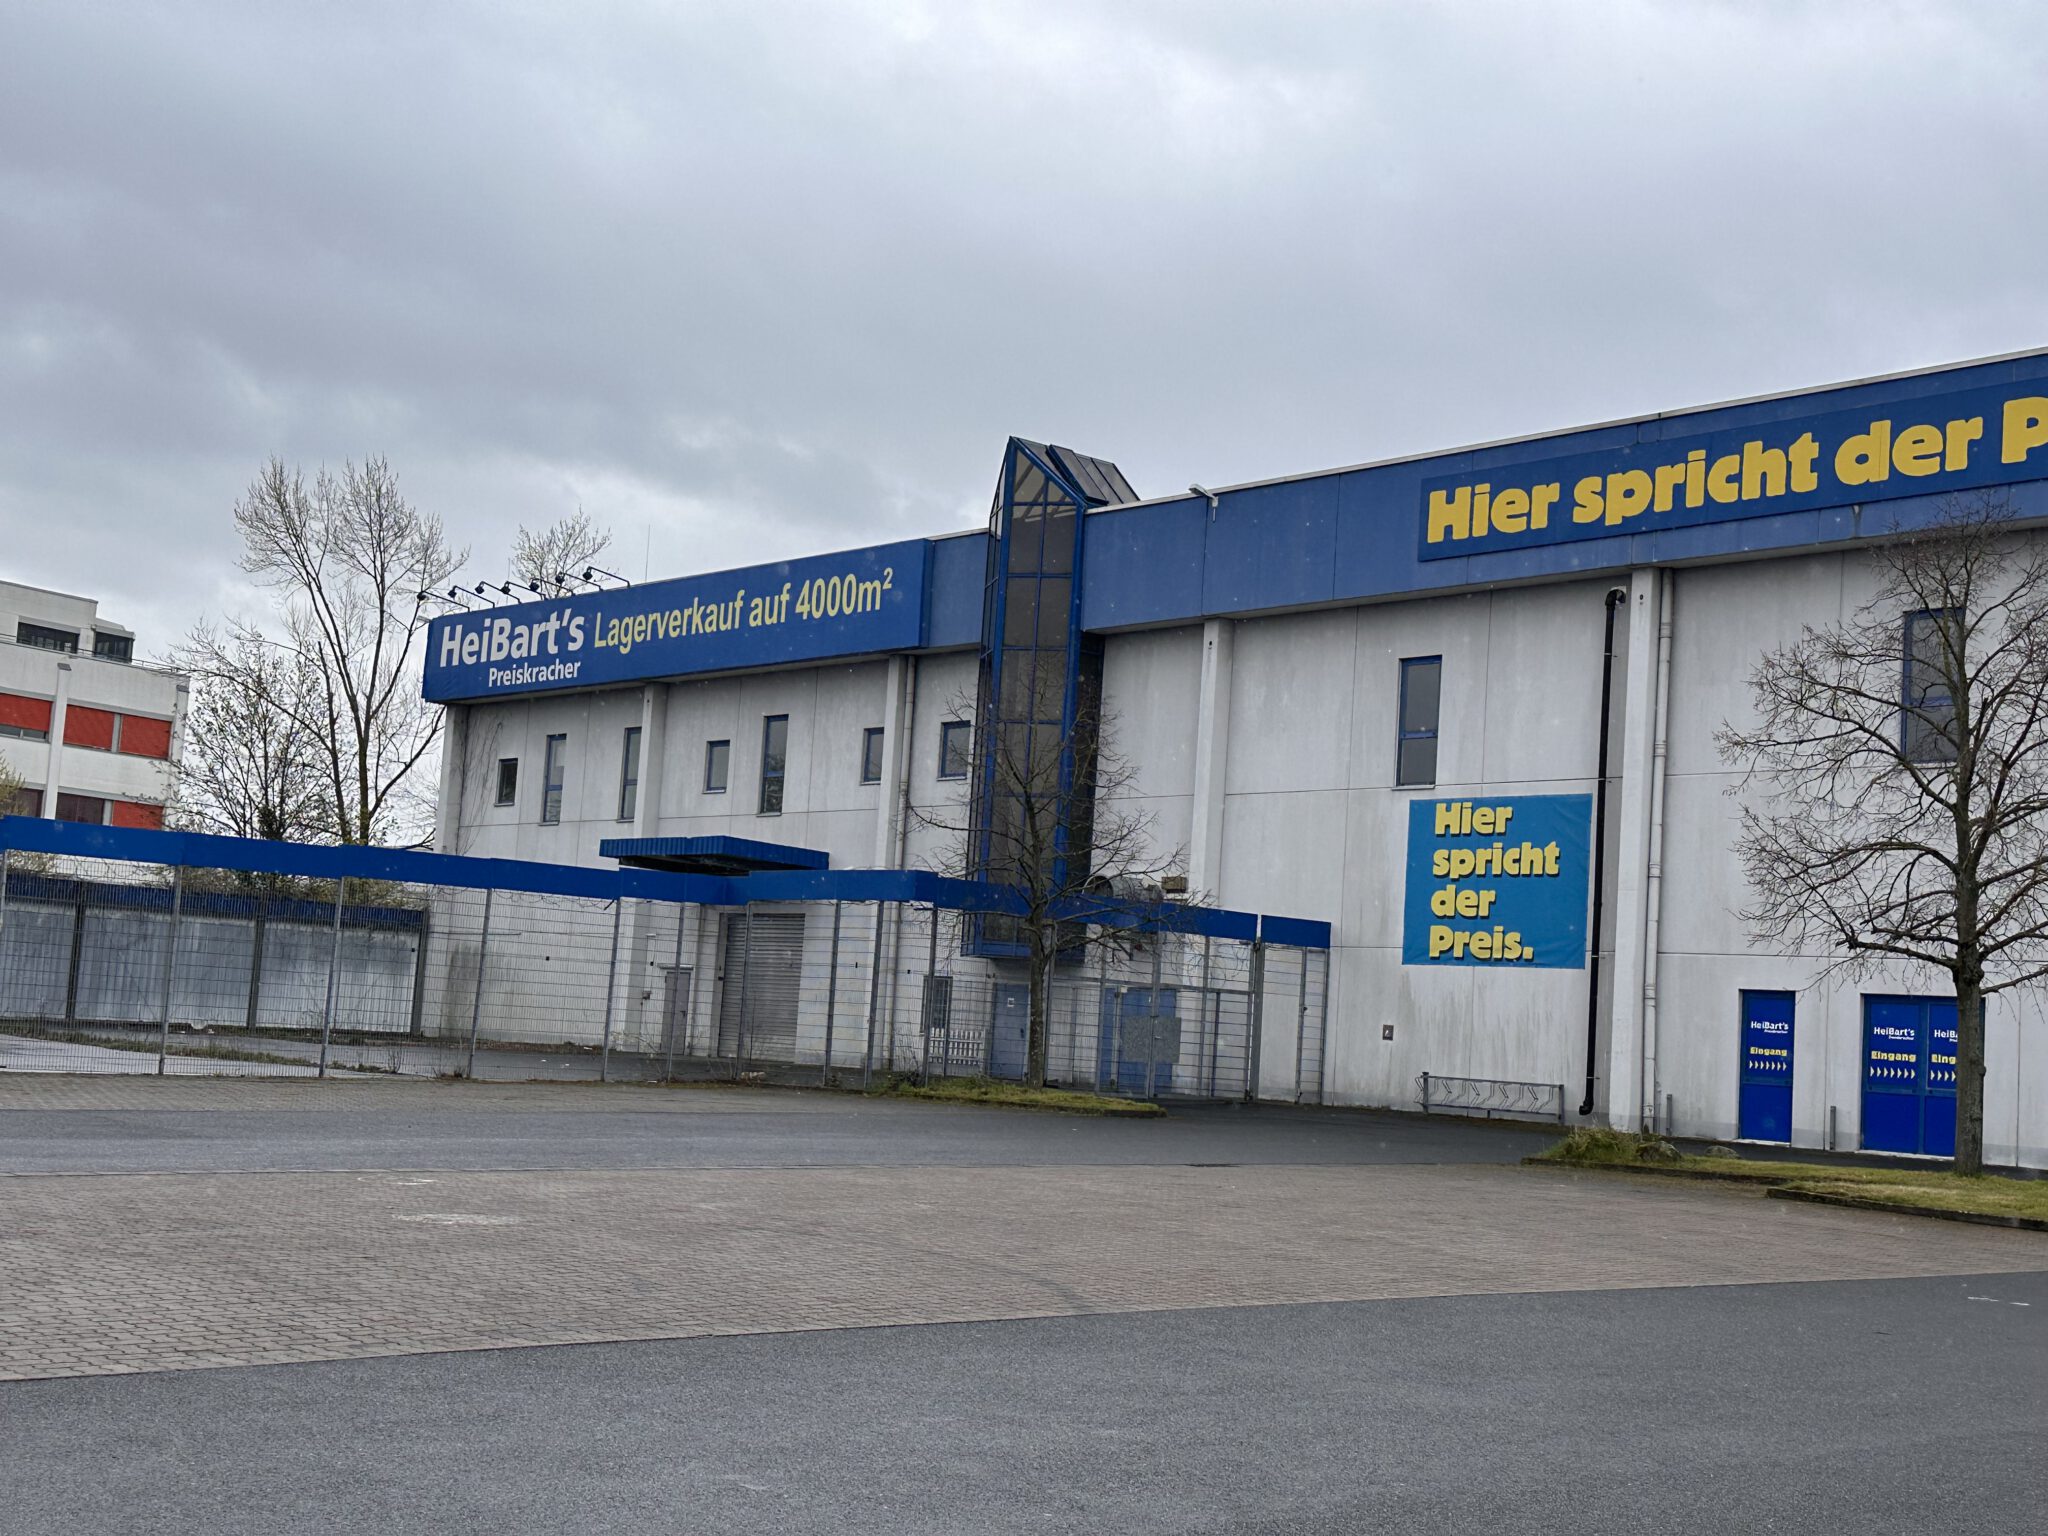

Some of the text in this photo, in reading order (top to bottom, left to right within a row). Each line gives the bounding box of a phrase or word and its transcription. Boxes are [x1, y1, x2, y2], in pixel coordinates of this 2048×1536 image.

[1426, 481, 1560, 544] Hier
[1572, 432, 1820, 526] spricht
[1833, 416, 1984, 487] der
[594, 567, 893, 655] Lagerverkauf auf 4000m²
[439, 607, 585, 668] HeiBart's
[488, 659, 582, 688] Preiskracher
[1434, 802, 1514, 836] Hier
[1432, 841, 1561, 881] spricht
[1430, 884, 1497, 919] der
[1429, 925, 1535, 962] Preis.
[1873, 1026, 1915, 1037] HeiBart's
[1750, 1046, 1788, 1057] Eingang
[1871, 1050, 1917, 1063] Eingang
